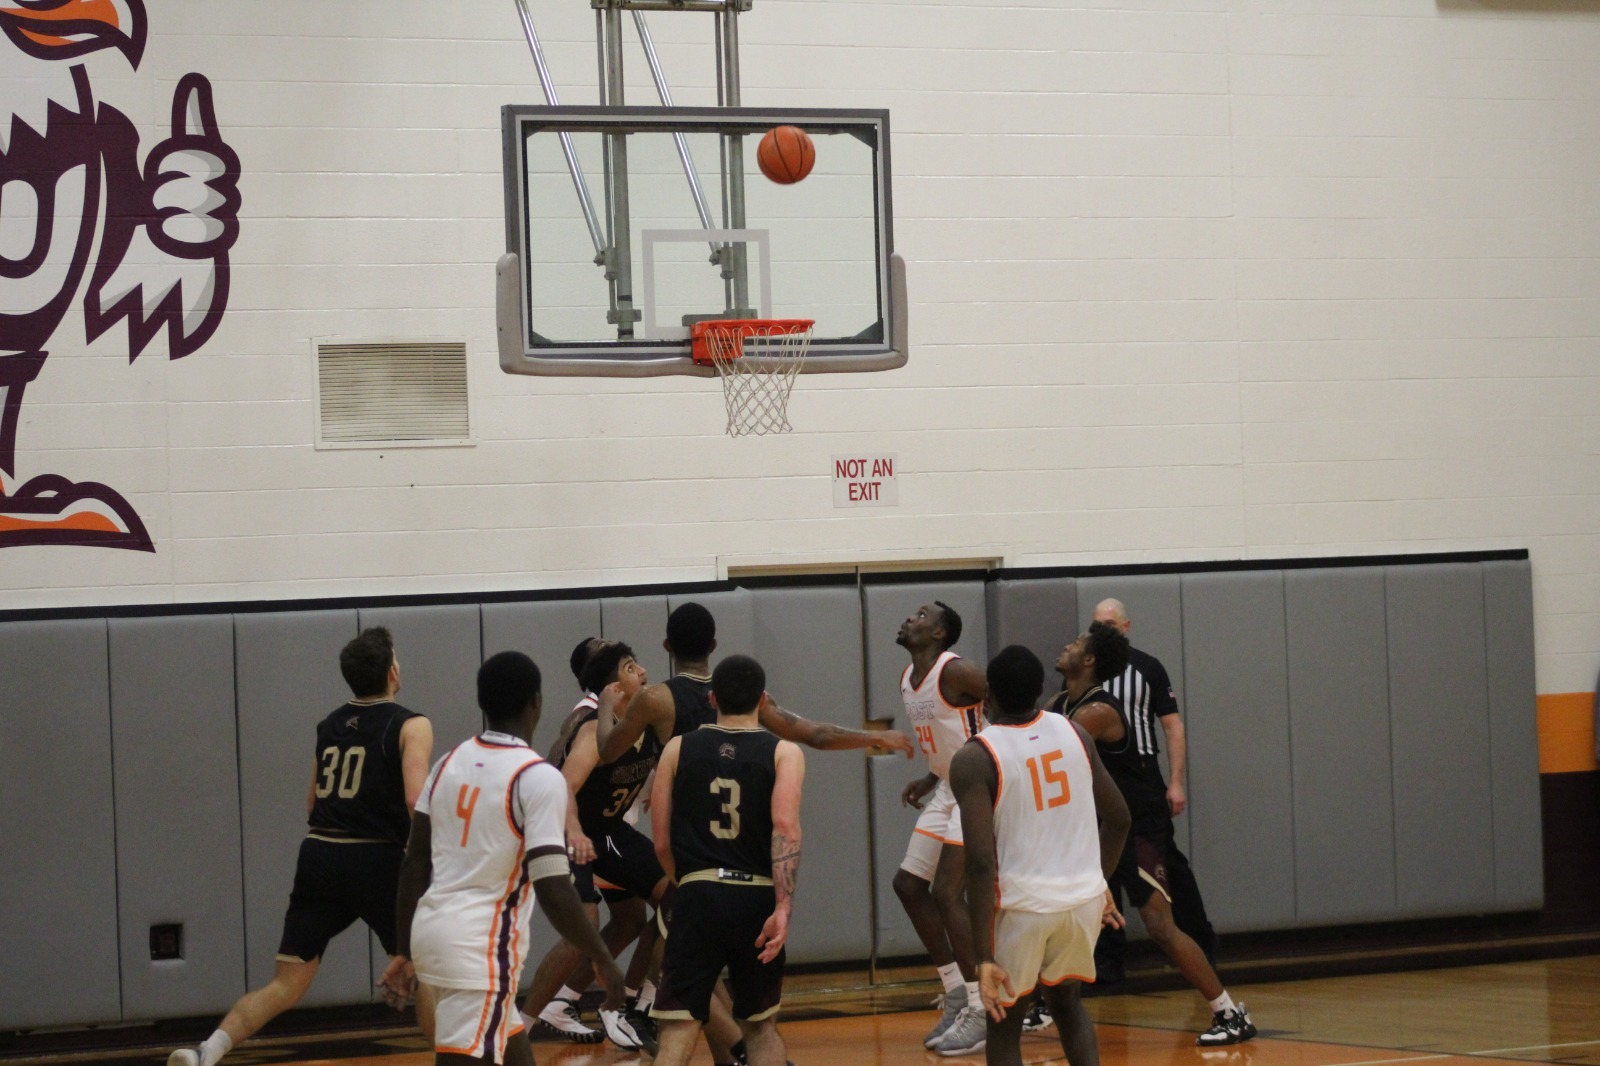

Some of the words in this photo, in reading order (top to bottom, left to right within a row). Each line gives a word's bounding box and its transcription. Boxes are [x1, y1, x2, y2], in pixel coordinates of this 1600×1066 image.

[836, 459, 867, 478] NOT
[872, 458, 893, 477] AN
[848, 482, 881, 501] EXIT
[915, 725, 938, 755] 24
[315, 746, 366, 798] 30
[1026, 749, 1071, 812] 15
[456, 783, 480, 848] 4
[709, 777, 740, 839] 3
